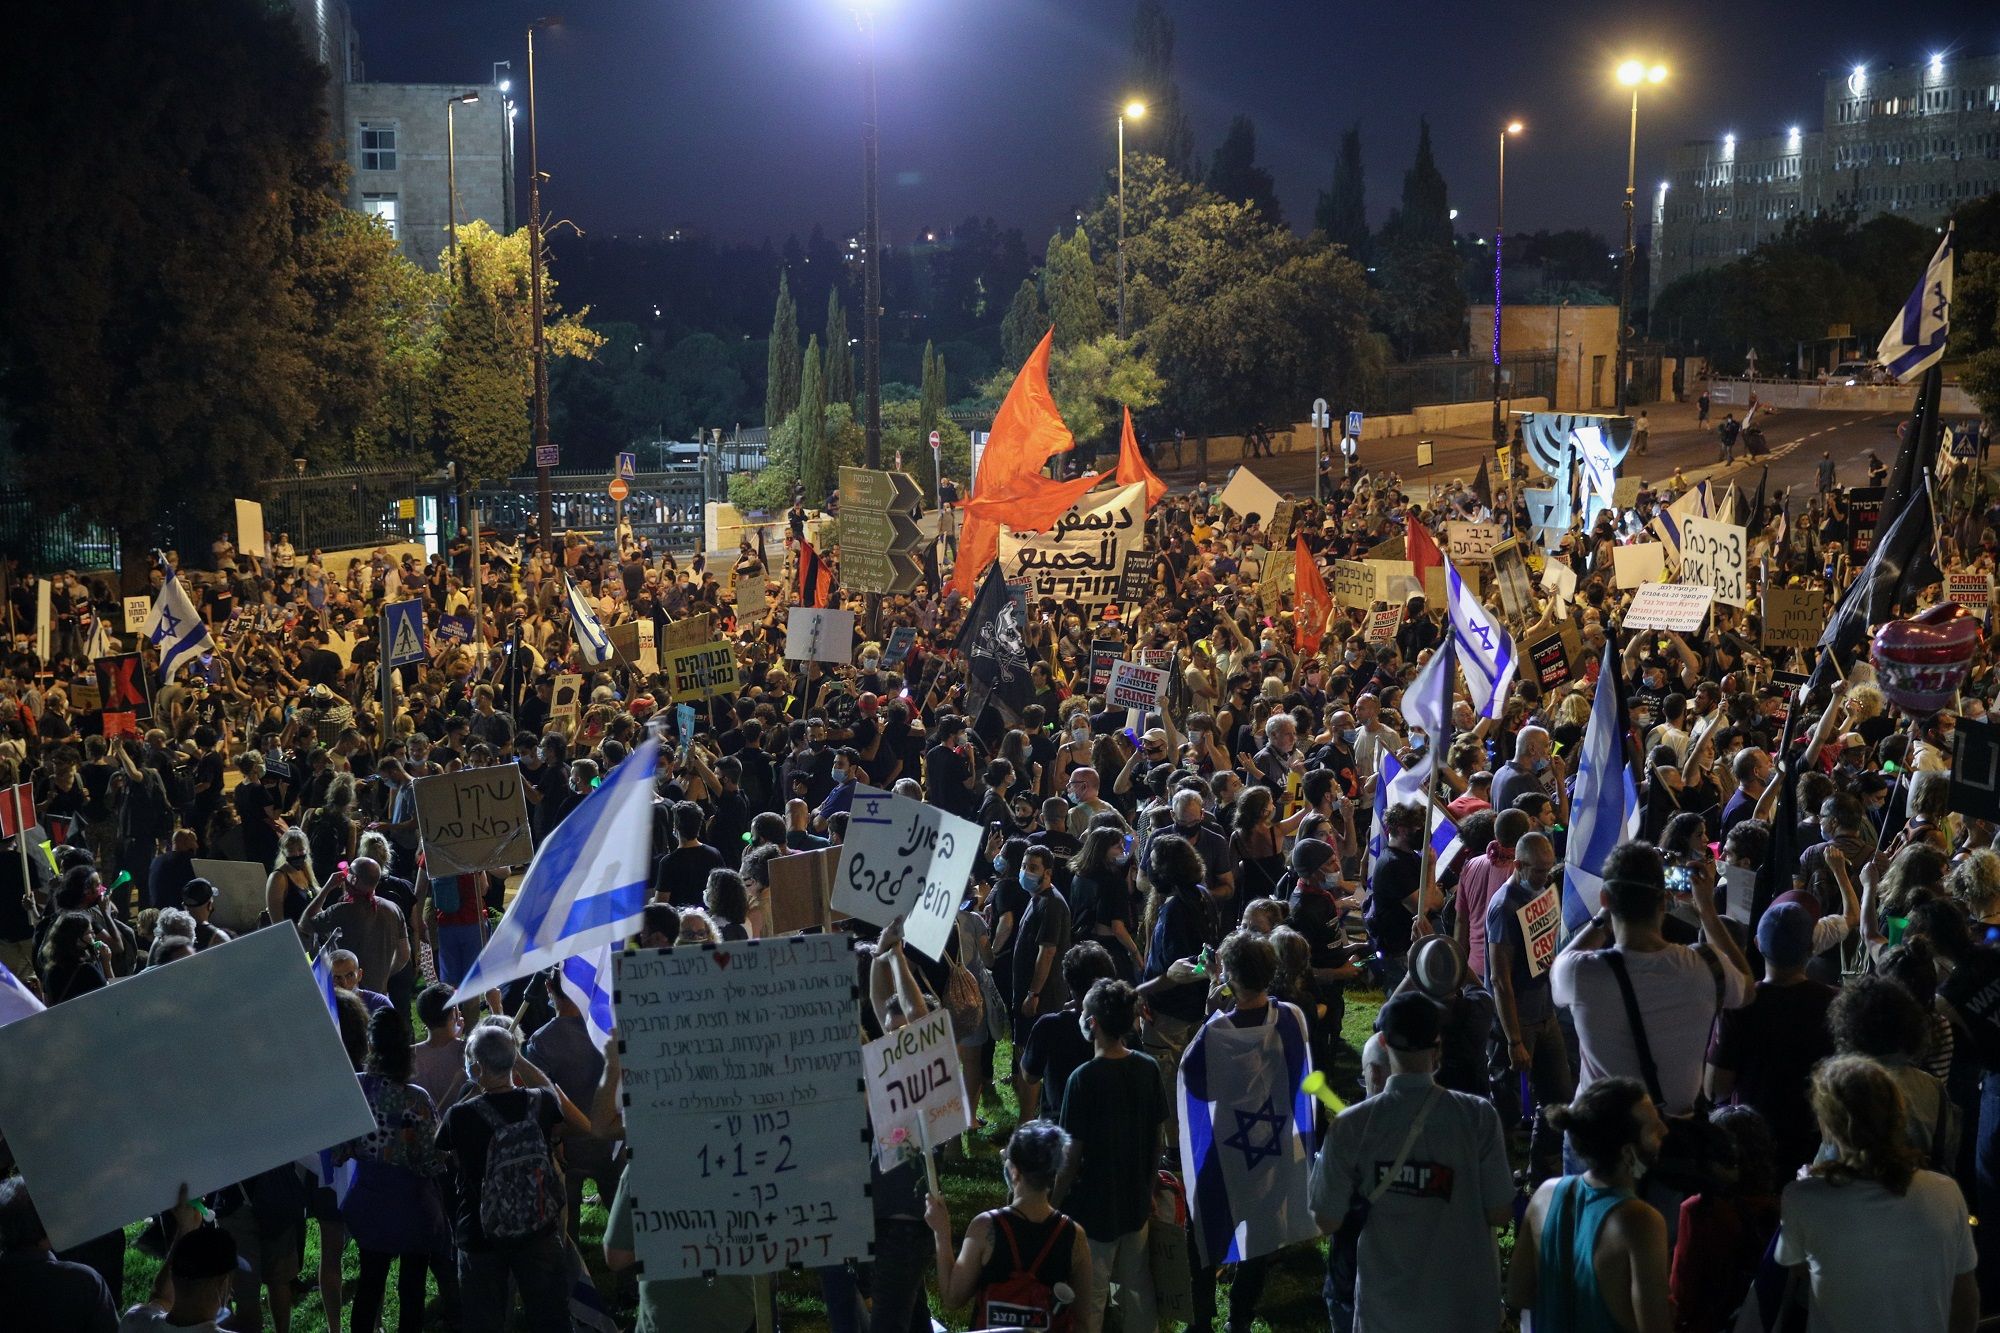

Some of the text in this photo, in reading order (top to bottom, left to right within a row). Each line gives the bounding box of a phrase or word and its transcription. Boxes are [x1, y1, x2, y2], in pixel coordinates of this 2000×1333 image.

[857, 495, 882, 506] Knesset
[1466, 528, 1492, 539] ביבי
[1018, 537, 1117, 577] للجميع
[1709, 533, 1741, 571] צריך
[1363, 568, 1373, 582] לא
[1950, 575, 1987, 584] CRIME
[1036, 576, 1121, 600] מוקרט
[1793, 593, 1814, 606] לא
[1950, 593, 1988, 602] CRIME
[1376, 609, 1399, 621] CRIME
[1783, 608, 1818, 627] לחוק
[675, 648, 731, 673] מנותקים
[1118, 665, 1160, 683] CRIME
[1116, 676, 1157, 691] MINISTER
[1113, 698, 1155, 712] MINISTER
[1114, 687, 1155, 705] CRIME
[453, 780, 516, 820] שקרן
[849, 852, 913, 906] לגרש
[1525, 890, 1555, 924] CRIME
[732, 951, 758, 970] שים
[803, 941, 837, 963] בני
[800, 976, 831, 991] אתה
[833, 974, 854, 989] אם
[629, 990, 662, 1007] בעד
[668, 987, 715, 1004] תצביעו
[721, 981, 747, 1004] שלך
[673, 1014, 693, 1031] את
[697, 1011, 729, 1029] חצית
[878, 1016, 945, 1078] ממשלת
[886, 1057, 952, 1114] בושה
[754, 1109, 791, 1135] כמו
[633, 1208, 717, 1233] ההסמכה
[726, 1209, 759, 1236] חוק
[785, 1201, 838, 1226] ביבי
[681, 1233, 834, 1269] דיקטטורה
[992, 1311, 1017, 1323] מצב
